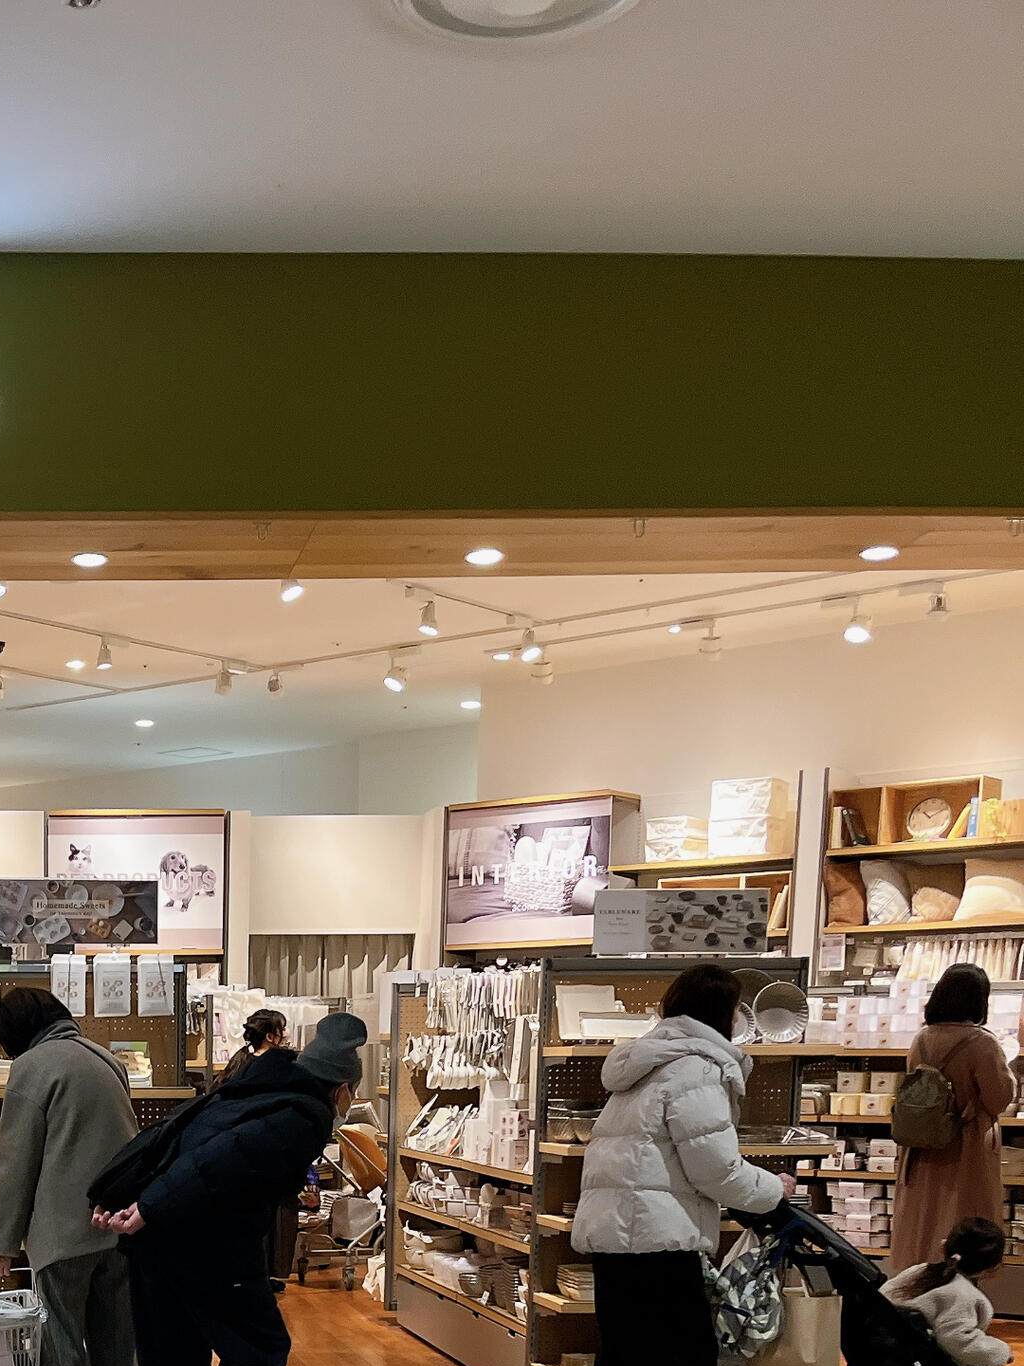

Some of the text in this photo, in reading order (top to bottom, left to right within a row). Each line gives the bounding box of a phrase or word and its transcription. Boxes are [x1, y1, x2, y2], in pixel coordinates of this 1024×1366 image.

[103, 870, 217, 892] UCTS
[458, 855, 598, 887] INTEROR
[36, 901, 77, 910] Homemade
